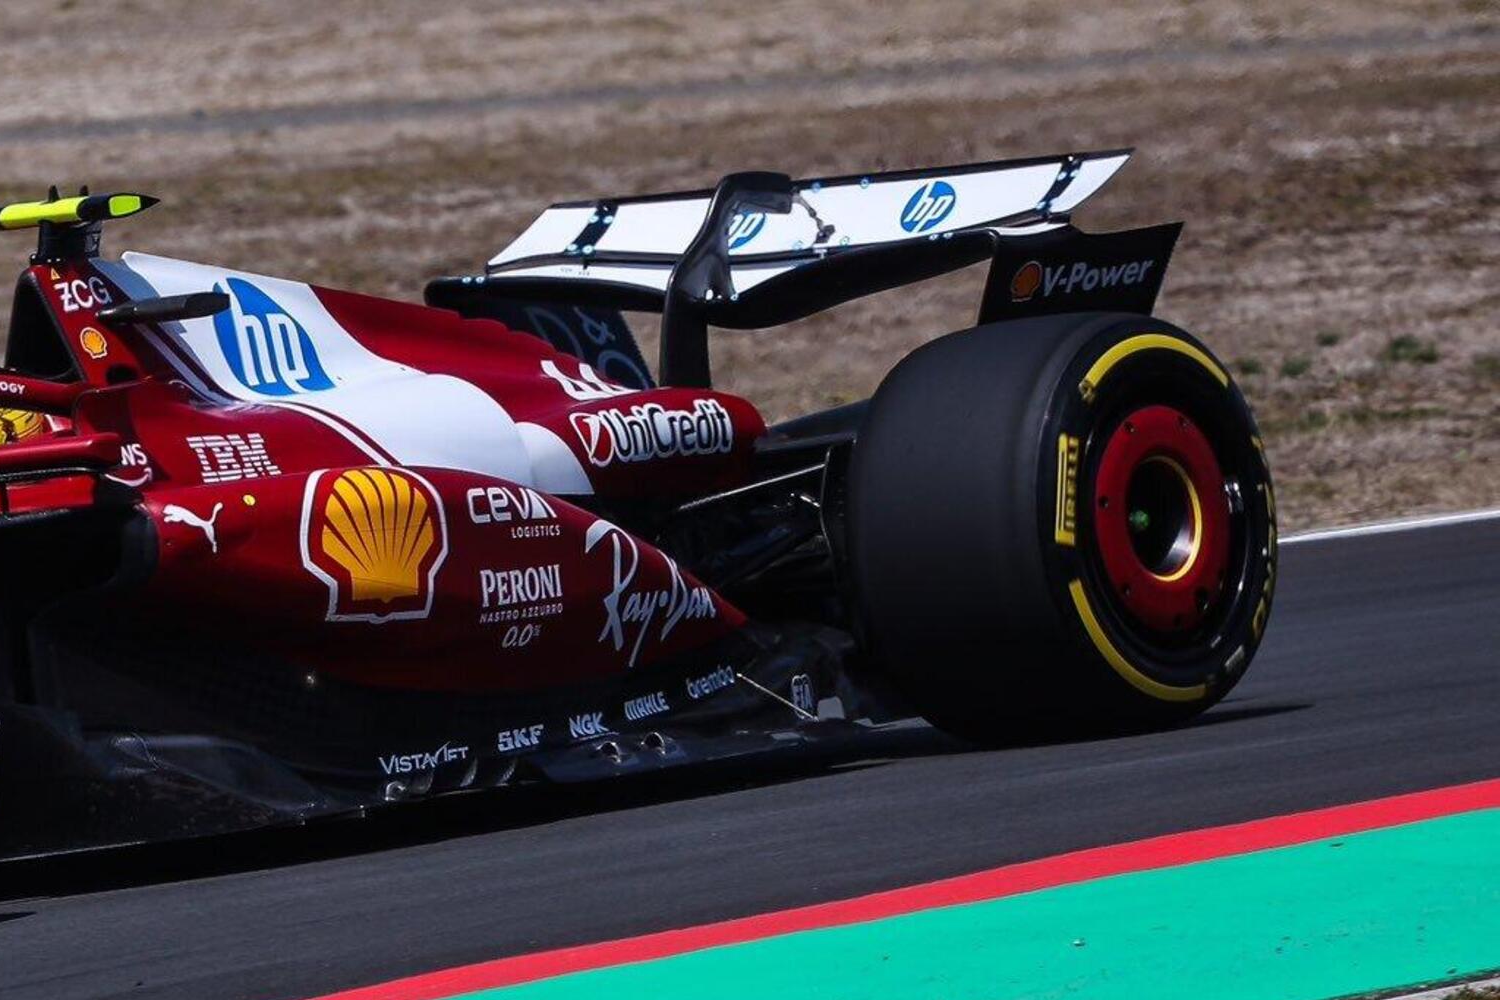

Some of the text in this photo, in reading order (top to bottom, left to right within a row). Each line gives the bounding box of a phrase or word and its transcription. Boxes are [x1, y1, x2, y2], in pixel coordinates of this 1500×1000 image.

[903, 179, 955, 233] hp
[1043, 259, 1154, 297] V-Power
[217, 278, 310, 394] hp
[600, 399, 733, 462] UniCredit
[186, 433, 282, 483] IBM
[511, 524, 561, 539] LOGISTICS
[480, 564, 563, 608] PERONI
[480, 602, 564, 624] NASTRO AZZURRO
[687, 665, 735, 700] brembo
[624, 692, 670, 722] MAHLE
[498, 724, 544, 751] SKF
[569, 713, 609, 739] NGK
